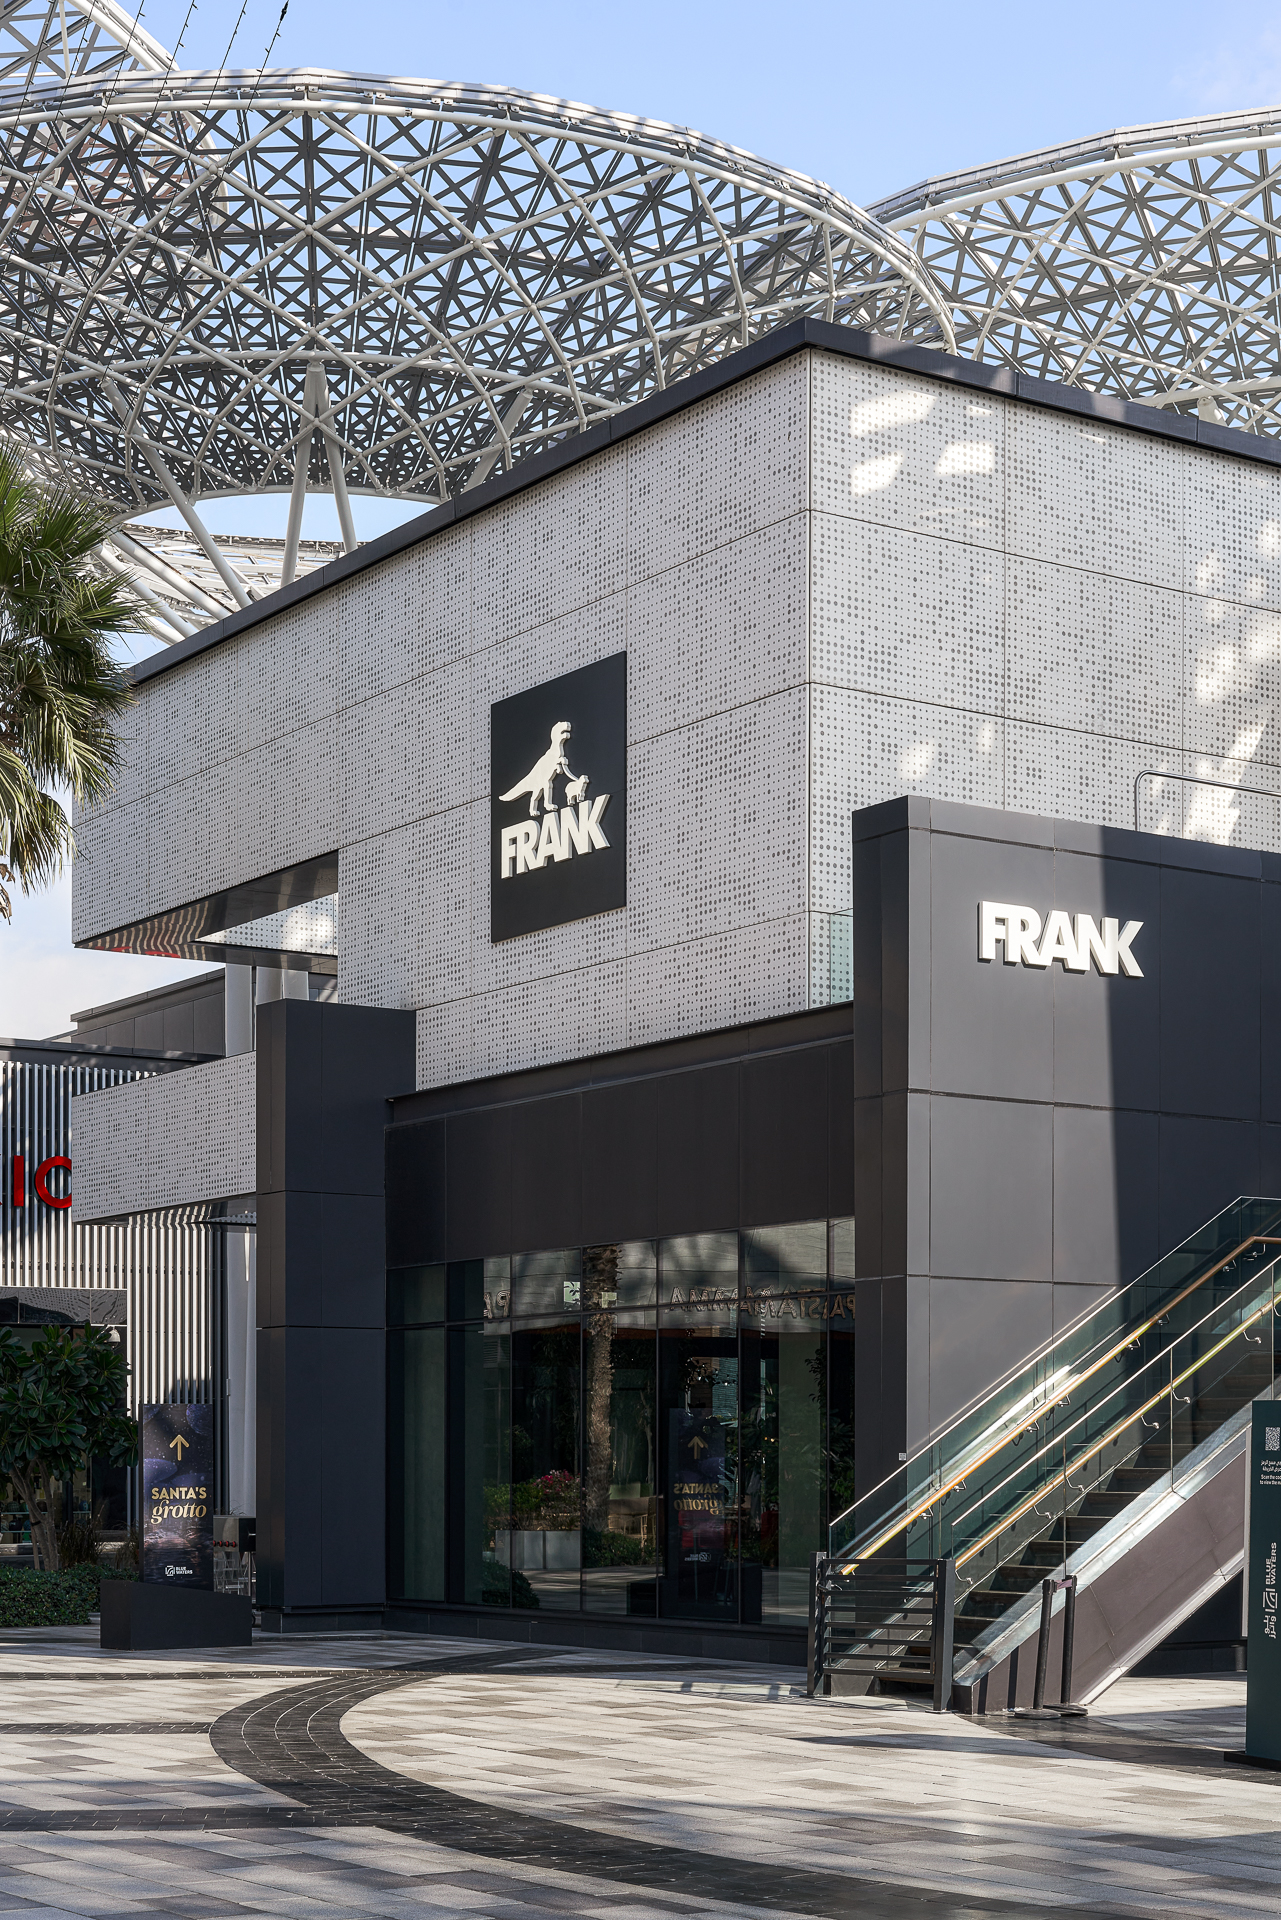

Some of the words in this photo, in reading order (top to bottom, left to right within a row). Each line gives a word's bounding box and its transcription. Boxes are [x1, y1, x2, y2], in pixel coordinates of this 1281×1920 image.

[500, 793, 611, 880] FRANK
[978, 900, 1145, 978] FRANK
[150, 1499, 207, 1525] grotto
[151, 1486, 207, 1500] SANTA'S
